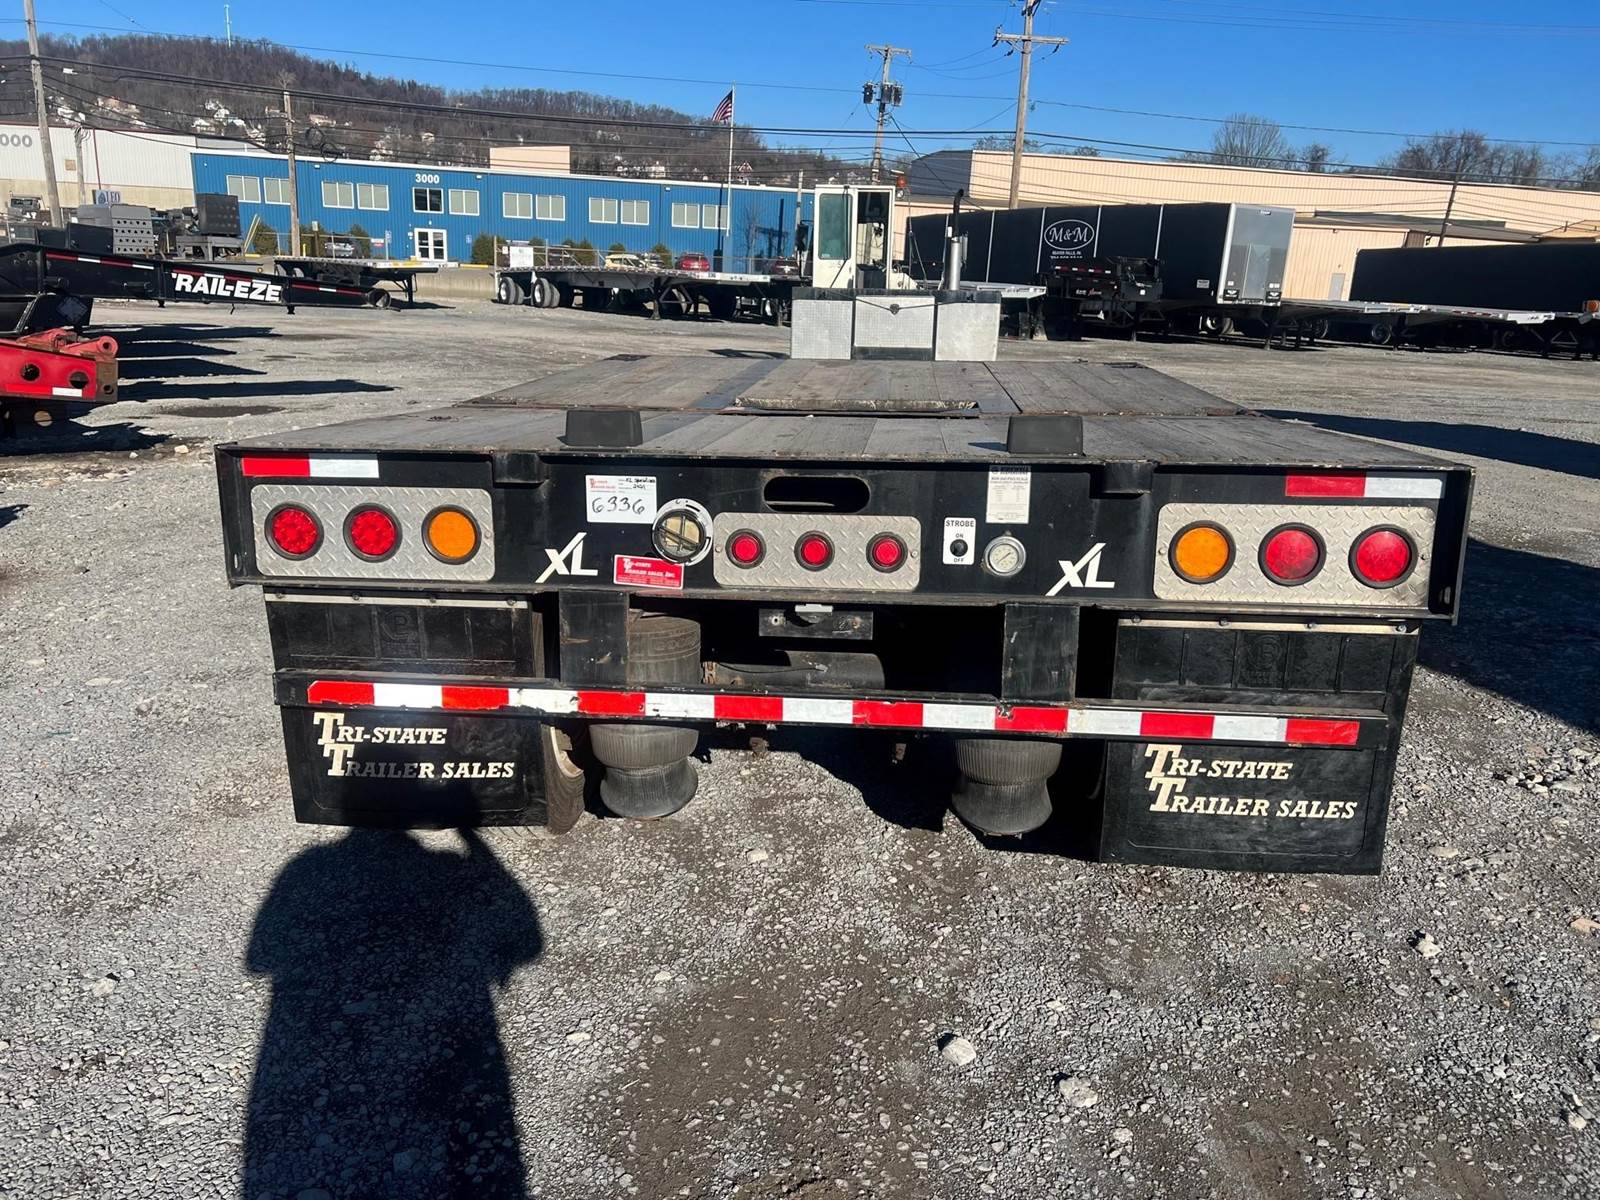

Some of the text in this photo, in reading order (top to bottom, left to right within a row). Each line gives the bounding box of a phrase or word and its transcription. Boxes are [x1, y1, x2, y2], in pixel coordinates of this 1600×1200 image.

[415, 173, 440, 184] 3000
[1049, 226, 1088, 242] M&M
[171, 272, 282, 303] RAIL-EZE
[591, 496, 646, 515] 6336
[534, 532, 599, 583] XL
[1044, 542, 1115, 597] XL
[313, 711, 448, 746] TRI-STATE
[323, 743, 515, 779] TRAILER SALES
[1144, 743, 1293, 780] TRI-STATE
[1149, 776, 1358, 819] TRAILER SALES
